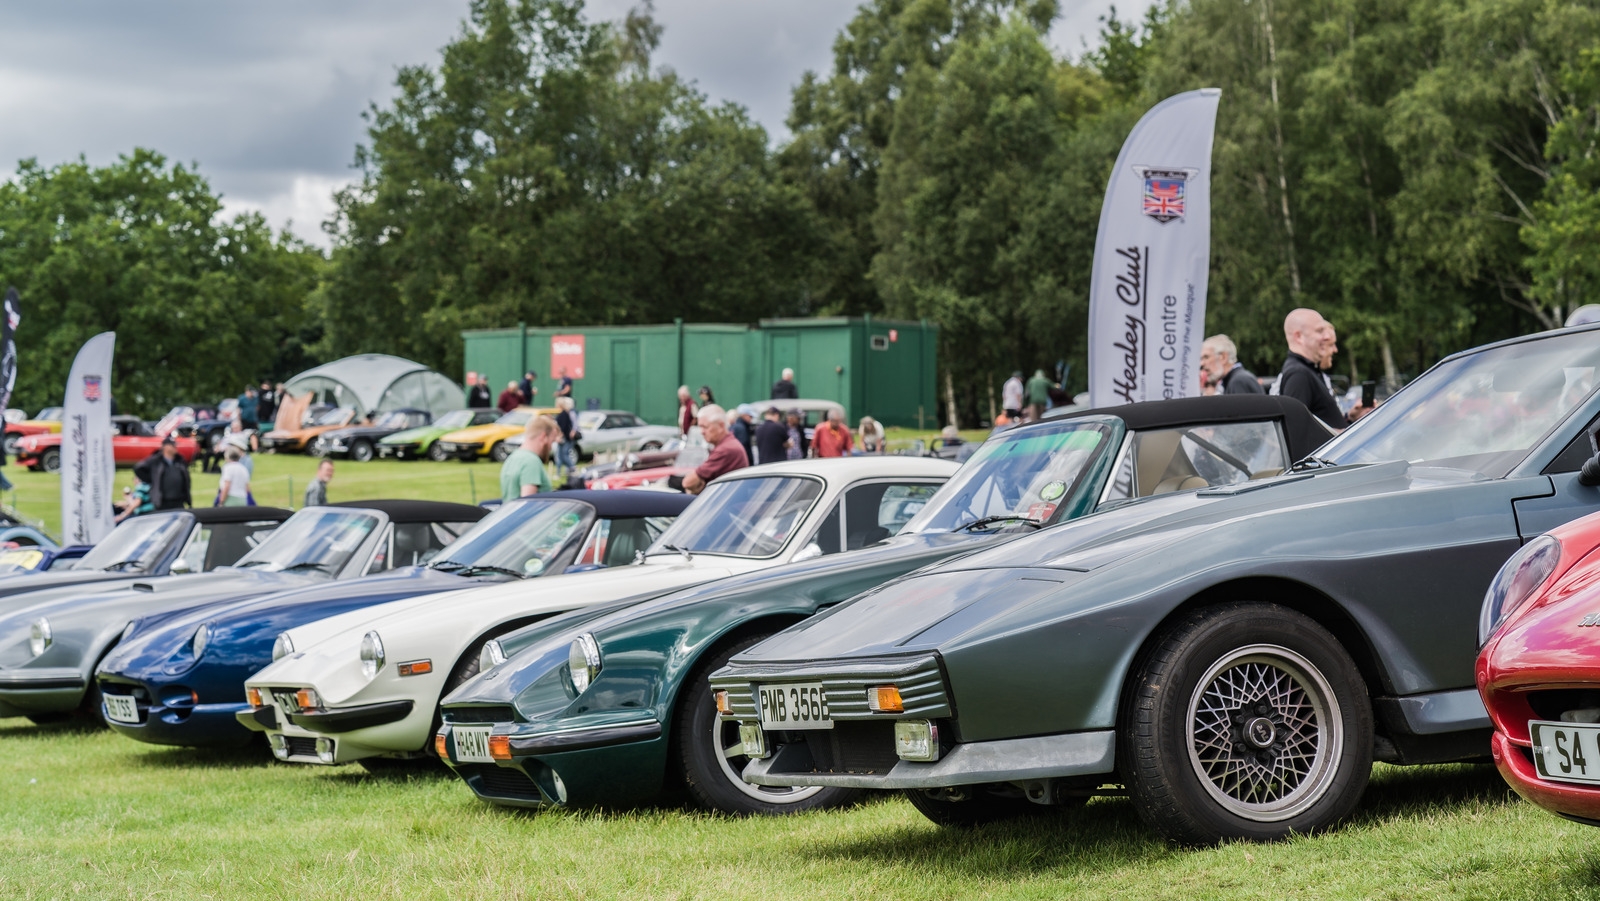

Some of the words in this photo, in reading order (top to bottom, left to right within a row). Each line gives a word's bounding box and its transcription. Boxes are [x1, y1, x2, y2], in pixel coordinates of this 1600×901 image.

[1116, 246, 1141, 307] Club
[1159, 294, 1177, 361] Centre
[1113, 315, 1146, 404] Healey
[760, 689, 787, 722] PMB
[1554, 730, 1587, 775] S4
